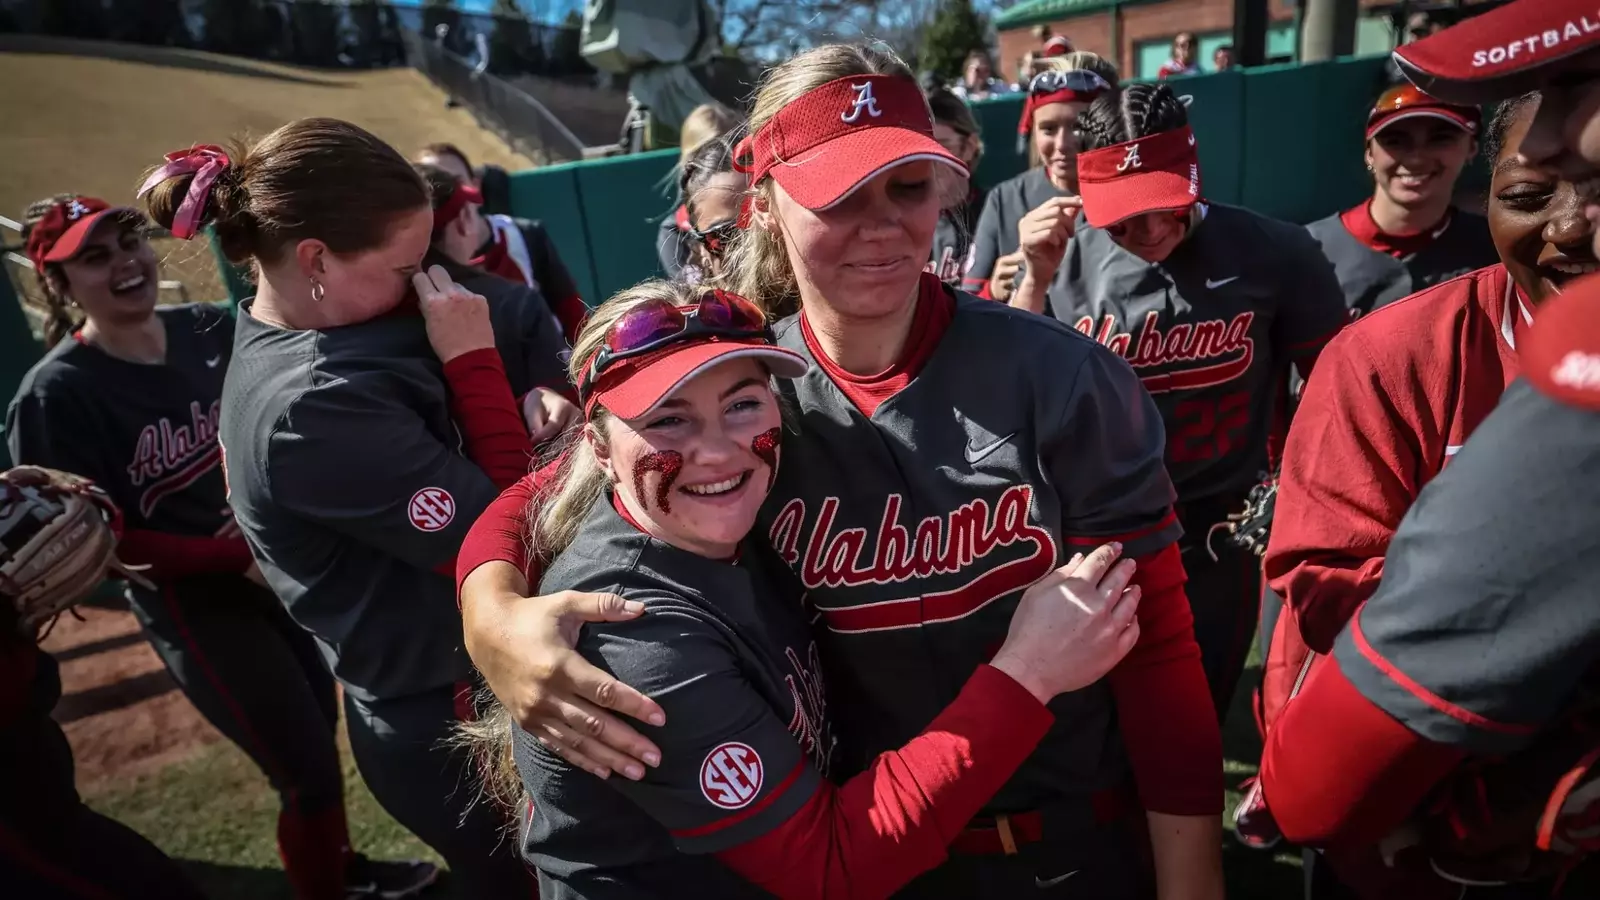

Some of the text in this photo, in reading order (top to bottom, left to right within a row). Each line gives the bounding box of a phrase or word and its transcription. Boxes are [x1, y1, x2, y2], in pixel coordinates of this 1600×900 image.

[1472, 7, 1600, 68] SOFTBAL
[841, 81, 882, 123] A
[1116, 143, 1142, 172] A
[411, 490, 452, 529] SEC
[704, 746, 758, 804] SEC
